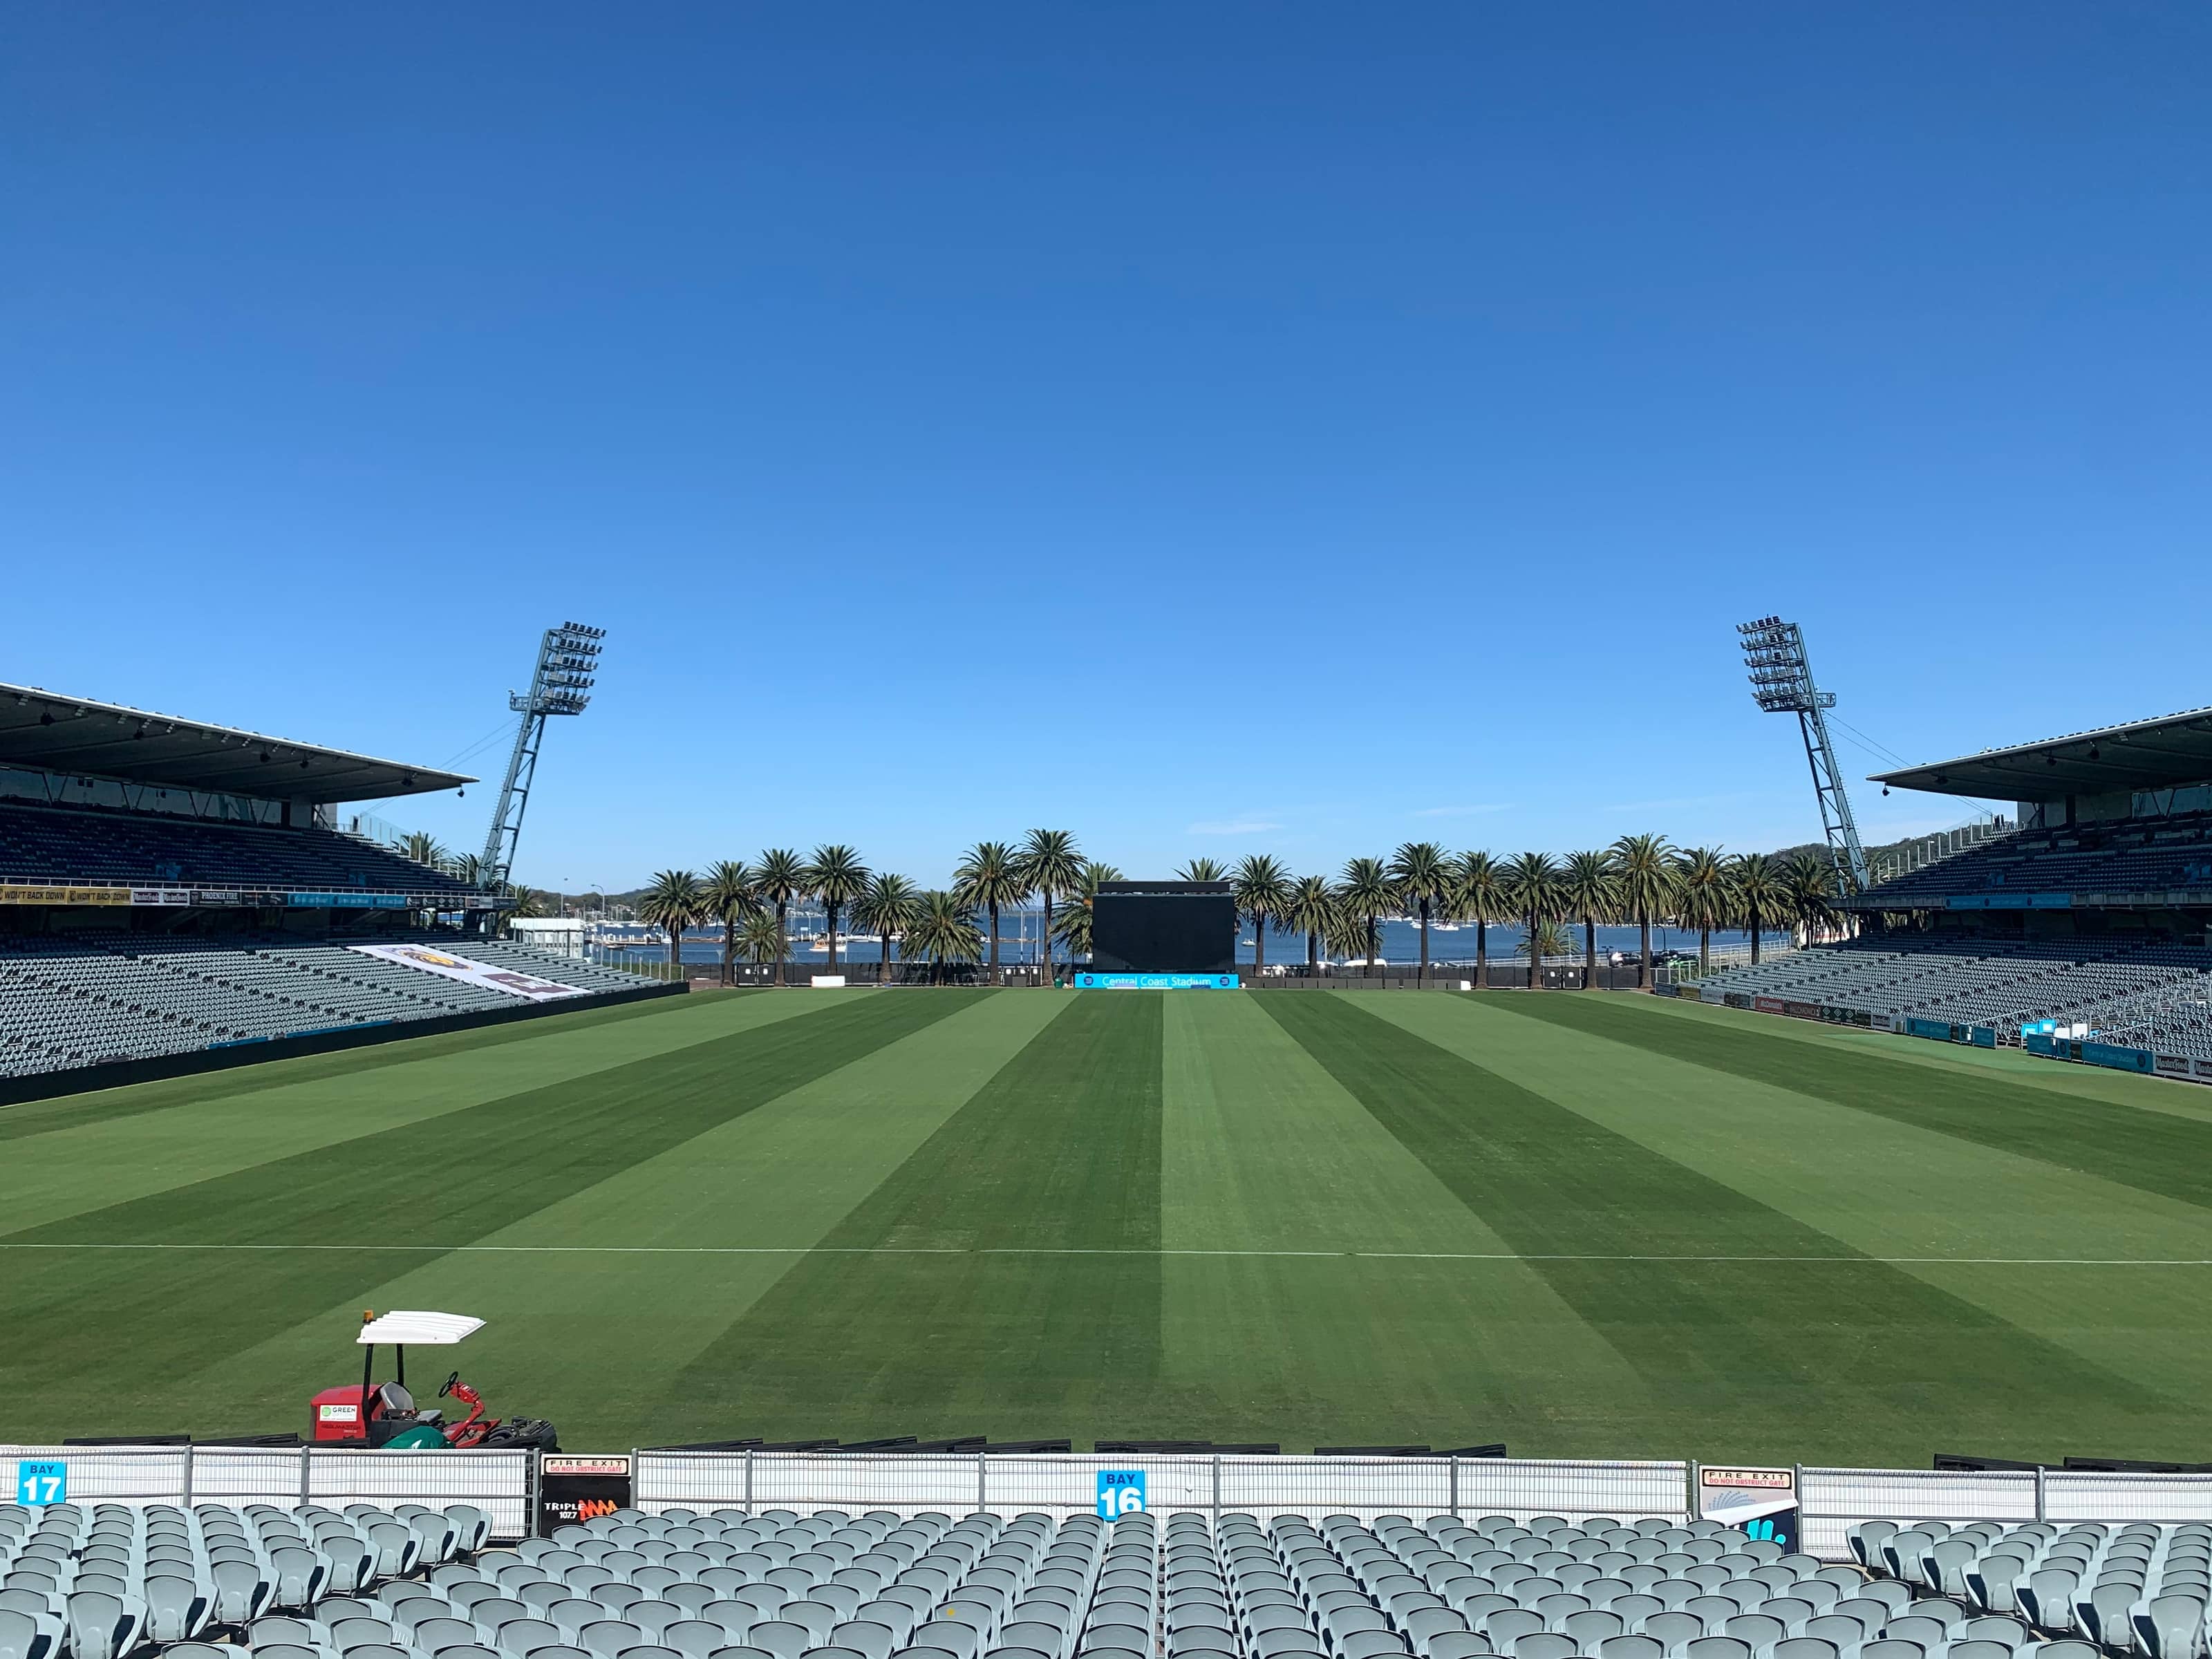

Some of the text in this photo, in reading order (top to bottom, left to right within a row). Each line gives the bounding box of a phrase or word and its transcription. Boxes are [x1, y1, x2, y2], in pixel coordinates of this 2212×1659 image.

[4, 890, 26, 899] WON'T
[27, 891, 44, 899] BACK
[77, 892, 95, 901] WON'T
[201, 892, 225, 900] PHOENIX
[1103, 976, 1211, 986] Central Coast Stadium
[30, 1465, 55, 1474] BAY
[1106, 1474, 1136, 1484] BAY
[24, 1476, 62, 1501] 17
[544, 1502, 585, 1510] TRIPLE
[1100, 1486, 1143, 1517] 16
[559, 1511, 578, 1519] 107.7
